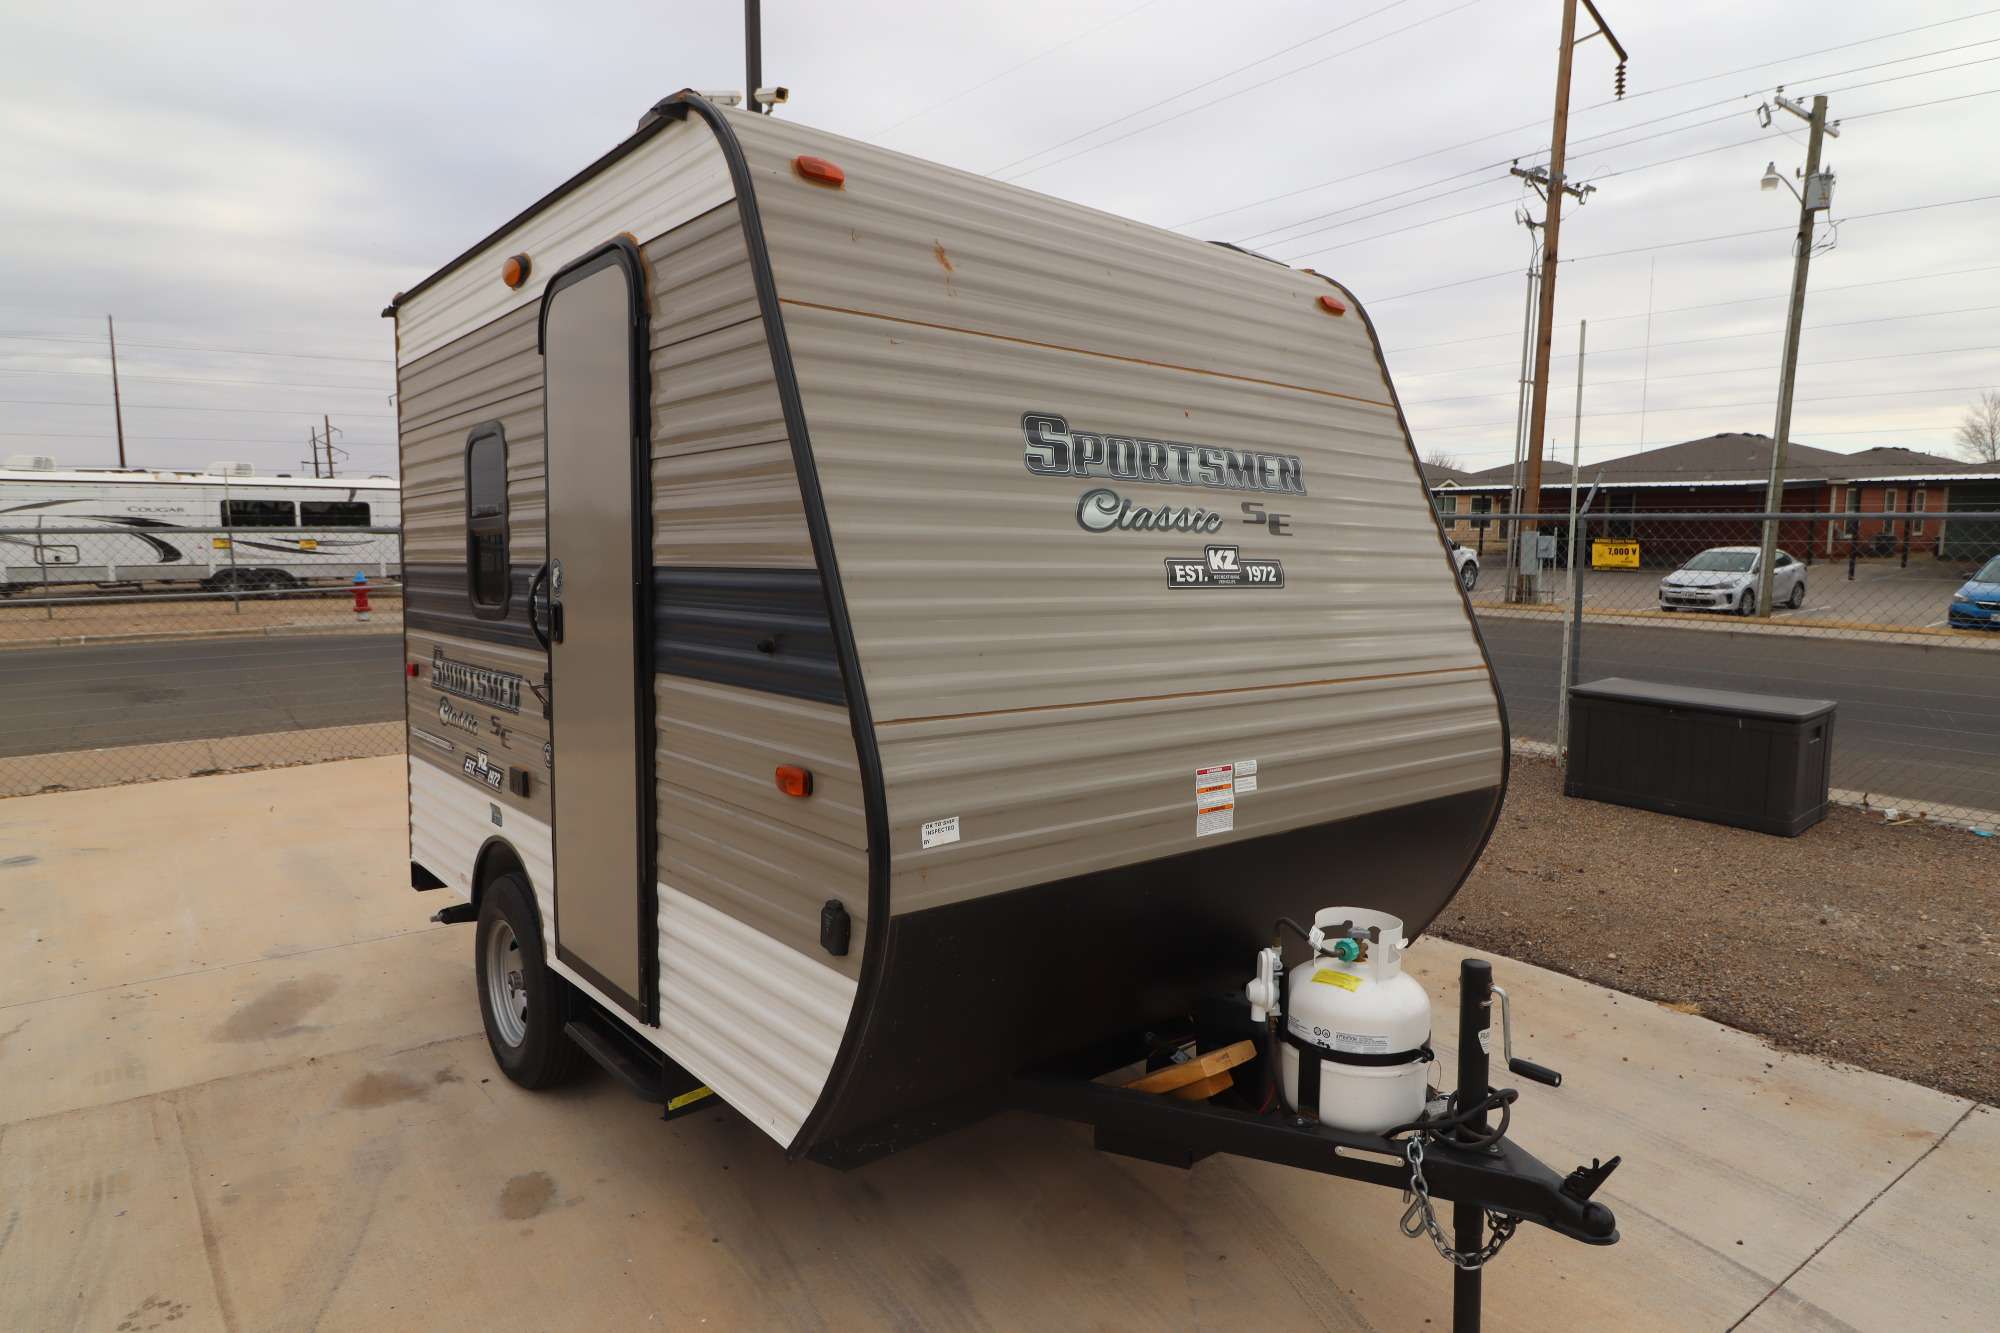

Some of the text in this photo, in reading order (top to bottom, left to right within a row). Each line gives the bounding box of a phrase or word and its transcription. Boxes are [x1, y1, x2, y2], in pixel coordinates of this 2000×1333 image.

[1021, 411, 1307, 496] SPORTSMEN
[127, 505, 185, 513] COUGAR
[1076, 488, 1294, 537] Classic SE
[1208, 549, 1239, 570] KZ
[1608, 547, 1637, 557] 7,000 V
[1174, 565, 1277, 583] EST. 1972
[487, 769, 501, 787] 1972
[925, 824, 955, 836] INSPECTED
